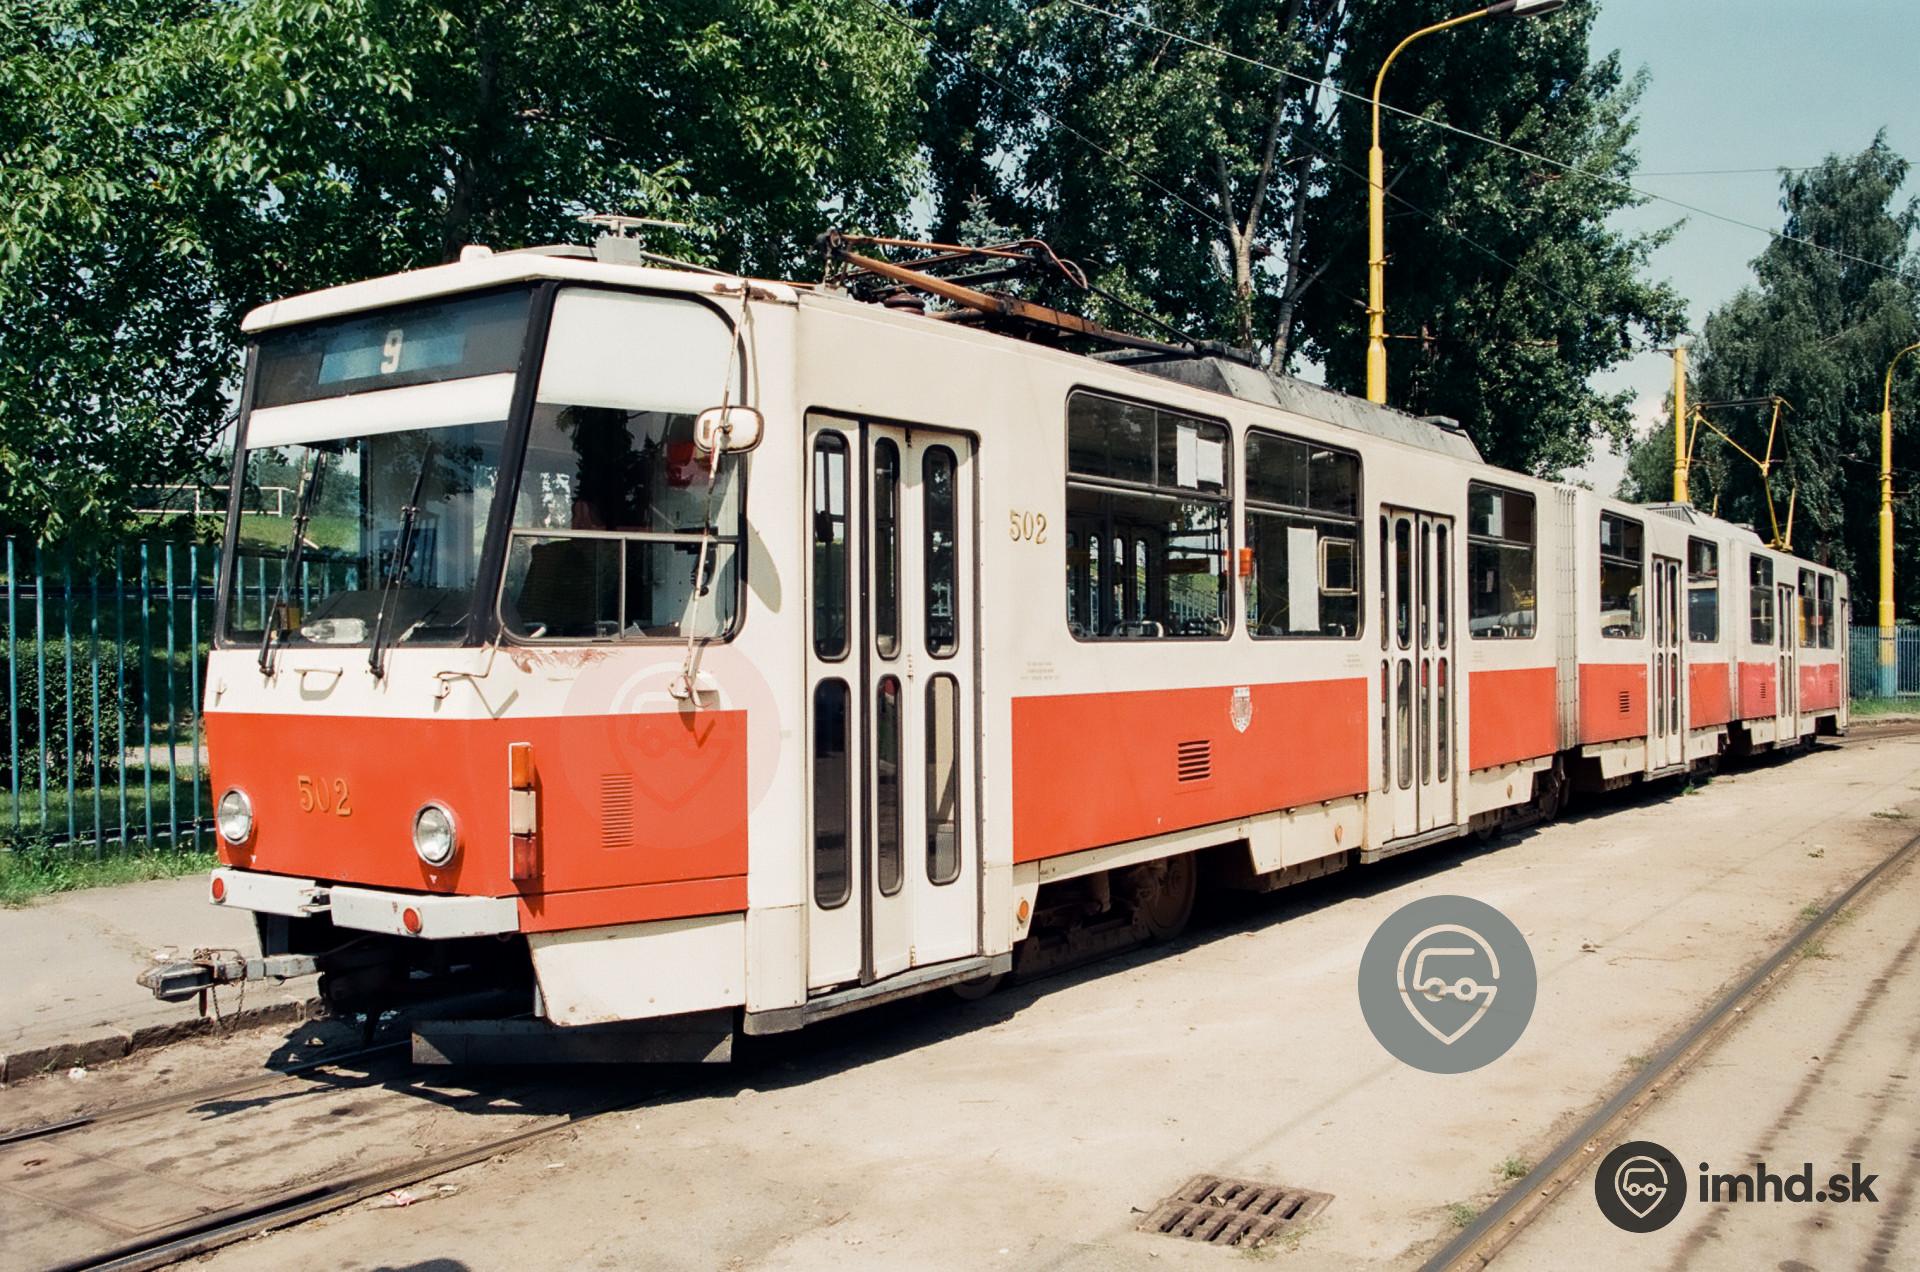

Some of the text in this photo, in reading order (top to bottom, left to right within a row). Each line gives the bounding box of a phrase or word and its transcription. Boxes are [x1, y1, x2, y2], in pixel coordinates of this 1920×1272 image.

[381, 329, 403, 374] 9
[1009, 509, 1047, 545] 502
[298, 775, 352, 817] 502
